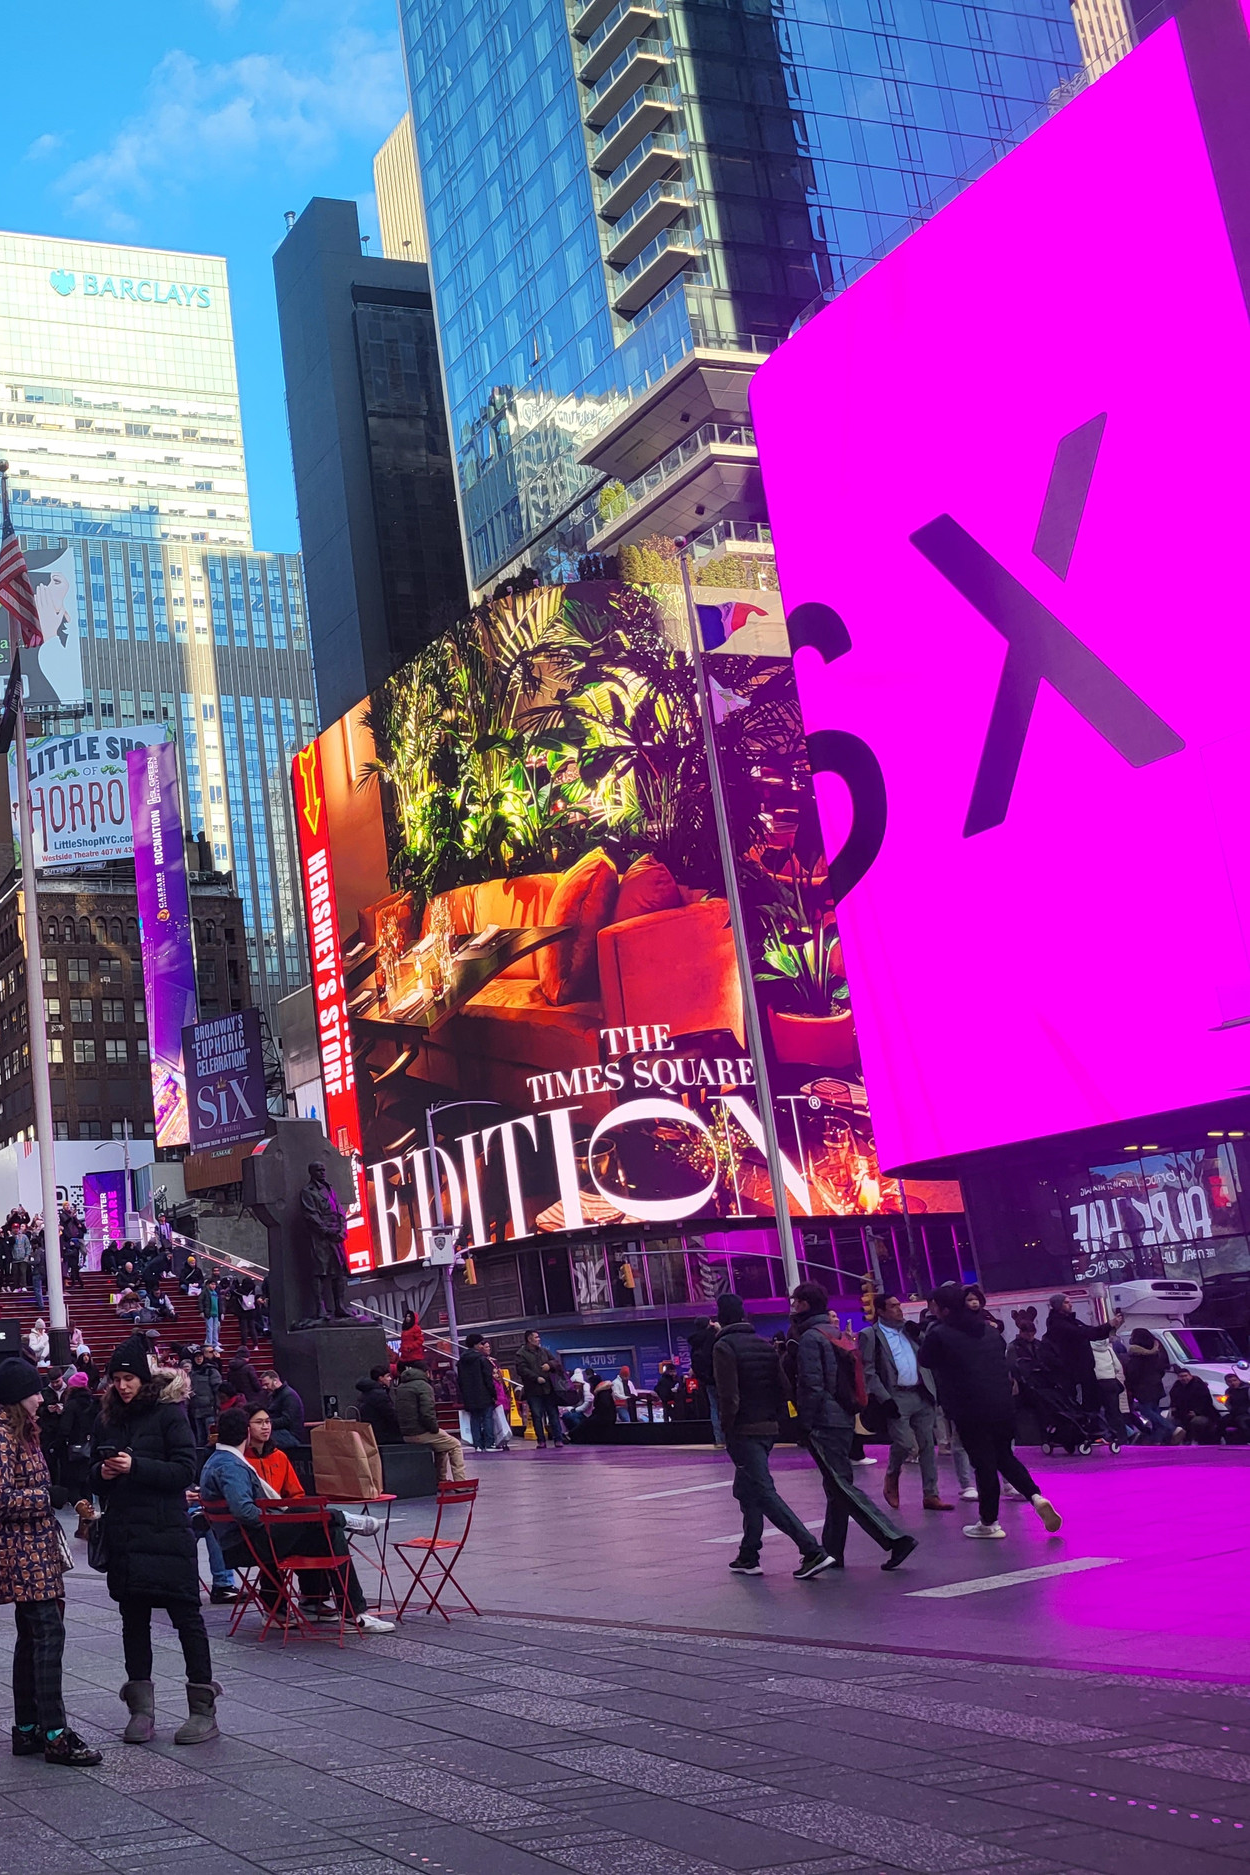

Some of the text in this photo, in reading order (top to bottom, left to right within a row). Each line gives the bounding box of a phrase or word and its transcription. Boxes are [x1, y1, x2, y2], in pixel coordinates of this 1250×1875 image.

[83, 274, 211, 308] BARCLAYS
[27, 736, 154, 783] LITTLE SH
[83, 767, 98, 776] OF
[29, 779, 125, 853] HORRO
[42, 853, 72, 862] Westside
[74, 850, 99, 860] Theatre
[156, 872, 164, 908] CAESARS
[307, 848, 337, 1001] HERSHEY'S
[194, 1014, 244, 1042] BROADWAY'S
[600, 1024, 675, 1056] THE
[526, 1058, 757, 1104] TIMES SQUARE
[197, 1075, 257, 1130] SIX
[99, 1192, 108, 1225] BETTER
[581, 1354, 617, 1367] 14,370 SF
[677, 1336, 691, 1376] LAGSHIP
